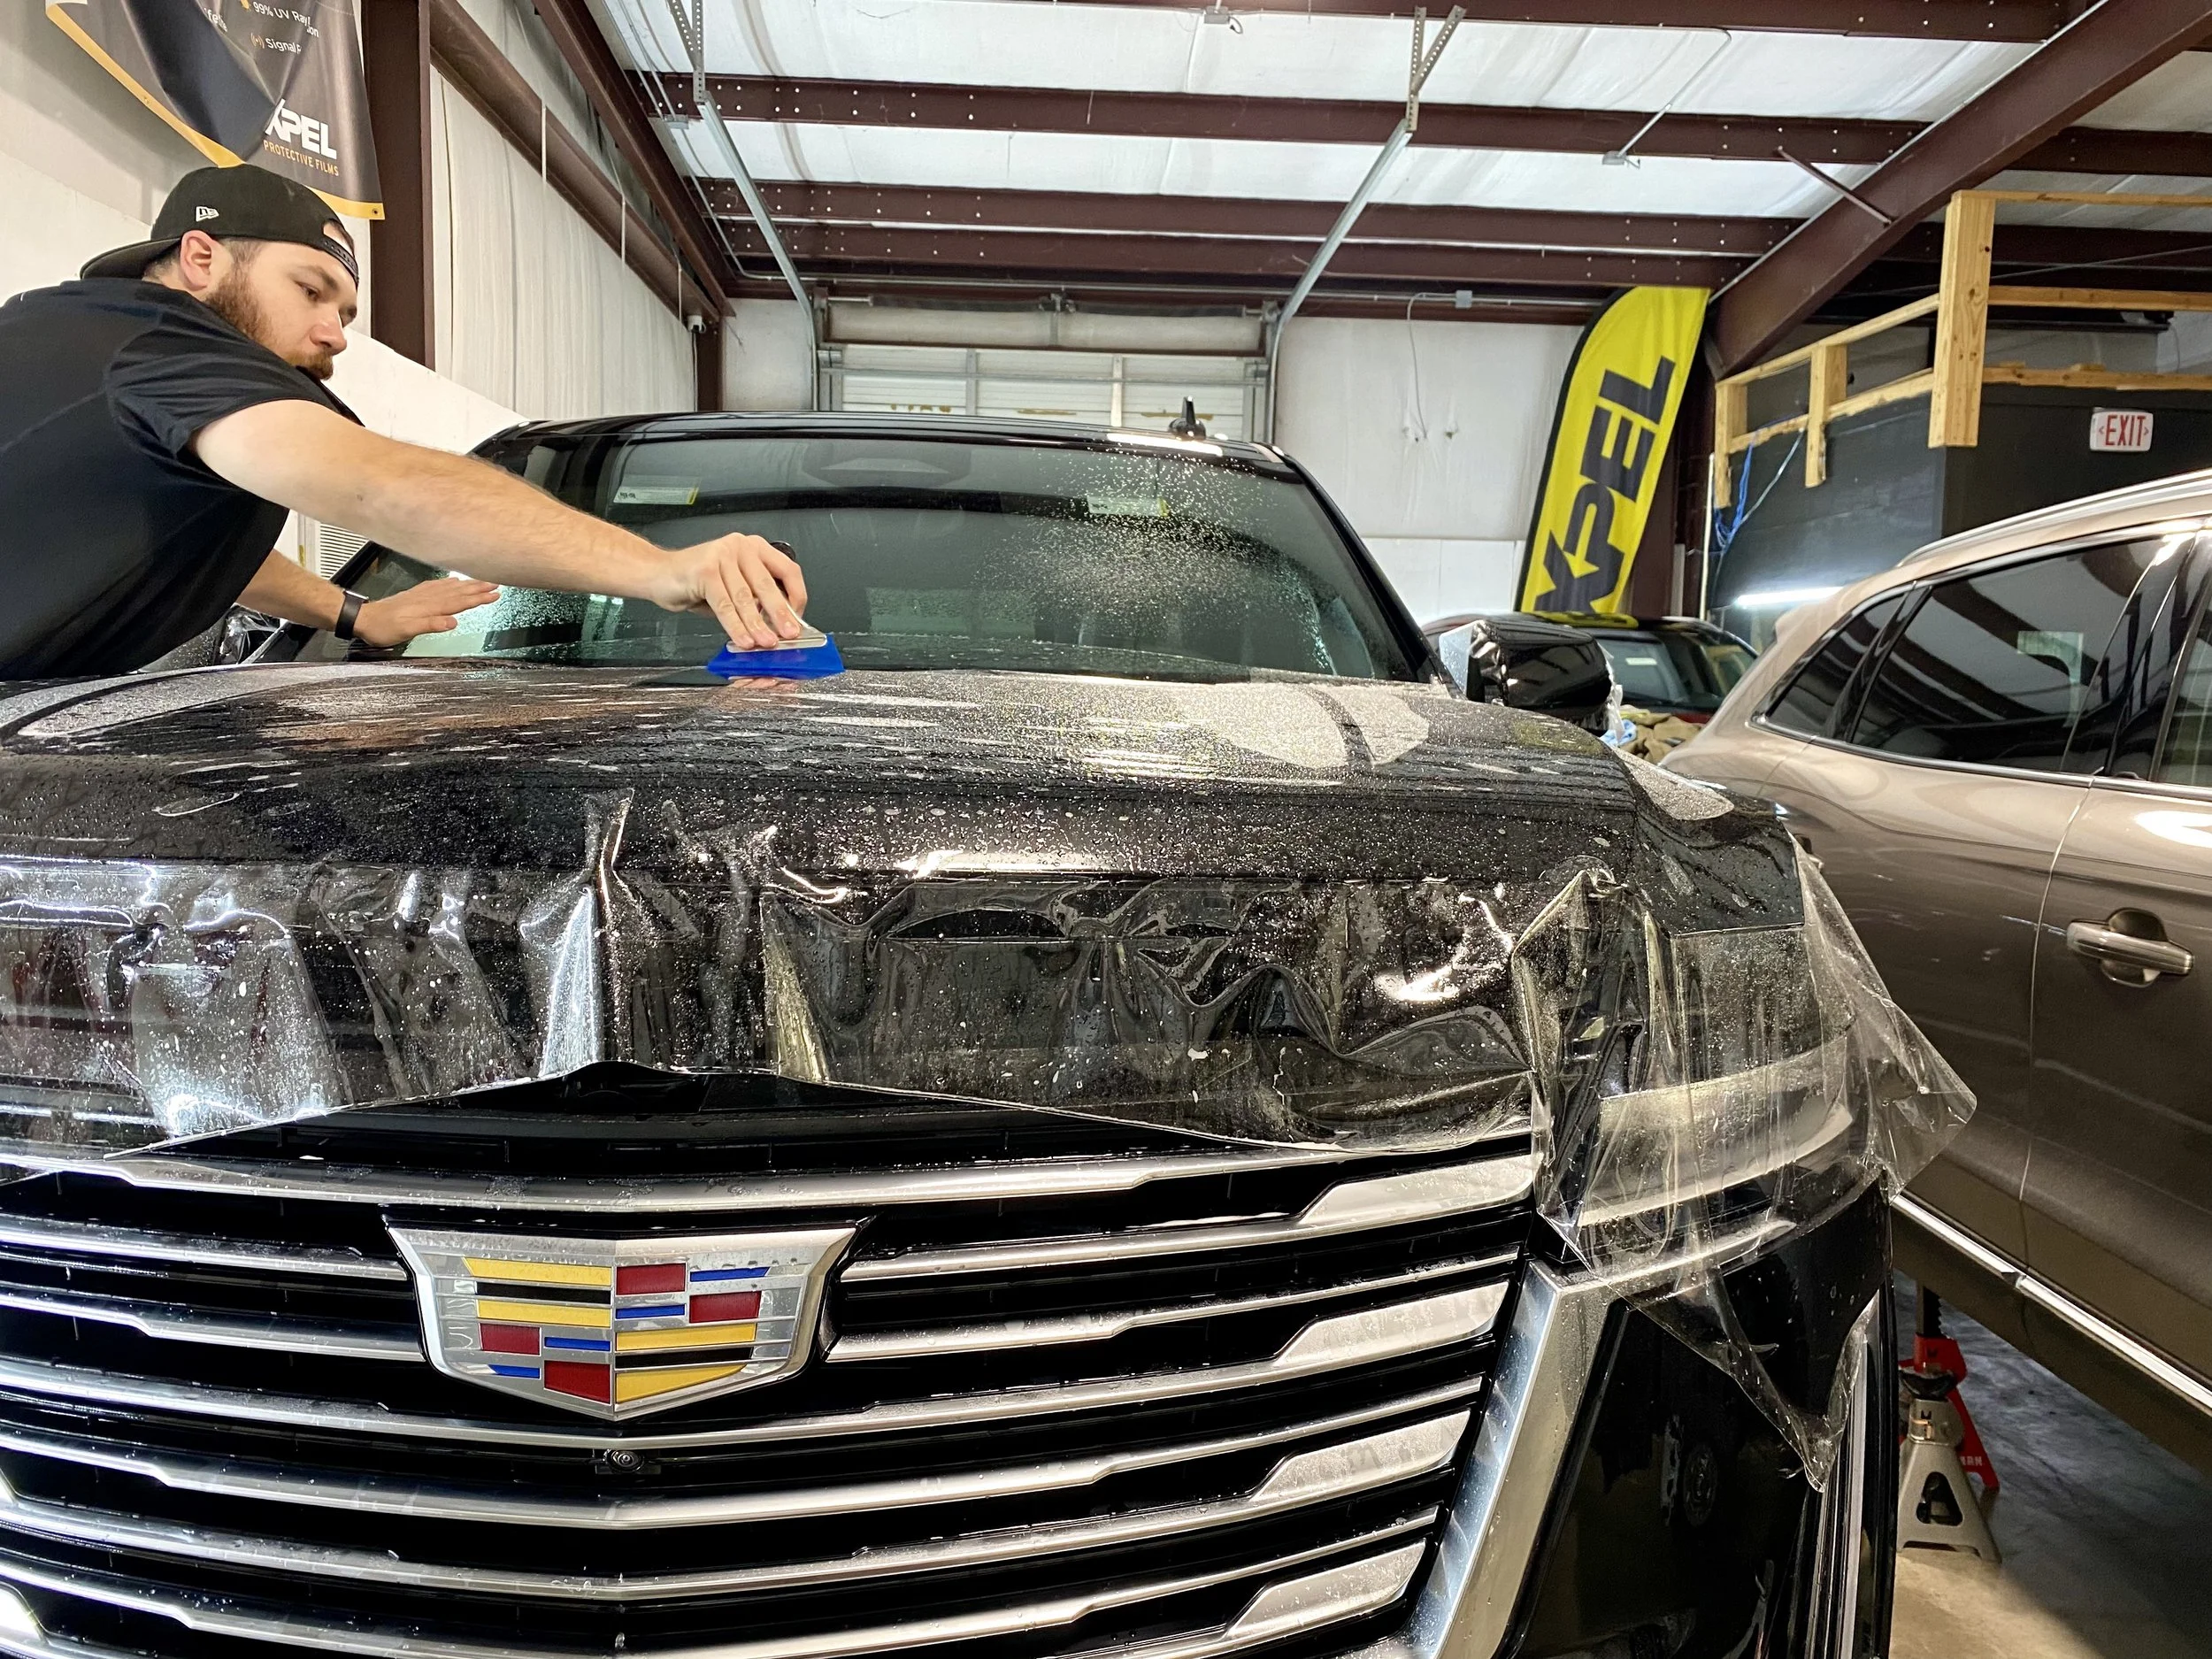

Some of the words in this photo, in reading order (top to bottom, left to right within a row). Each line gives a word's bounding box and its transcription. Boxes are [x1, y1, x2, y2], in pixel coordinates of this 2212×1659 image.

[253, 1, 274, 17] 99%
[273, 7, 289, 19] UV
[265, 38, 296, 53] Signal
[265, 98, 337, 159] XPEL
[263, 140, 314, 167] PROTECTIVE
[314, 158, 339, 176] FILMS
[2105, 414, 2147, 447] EXIT
